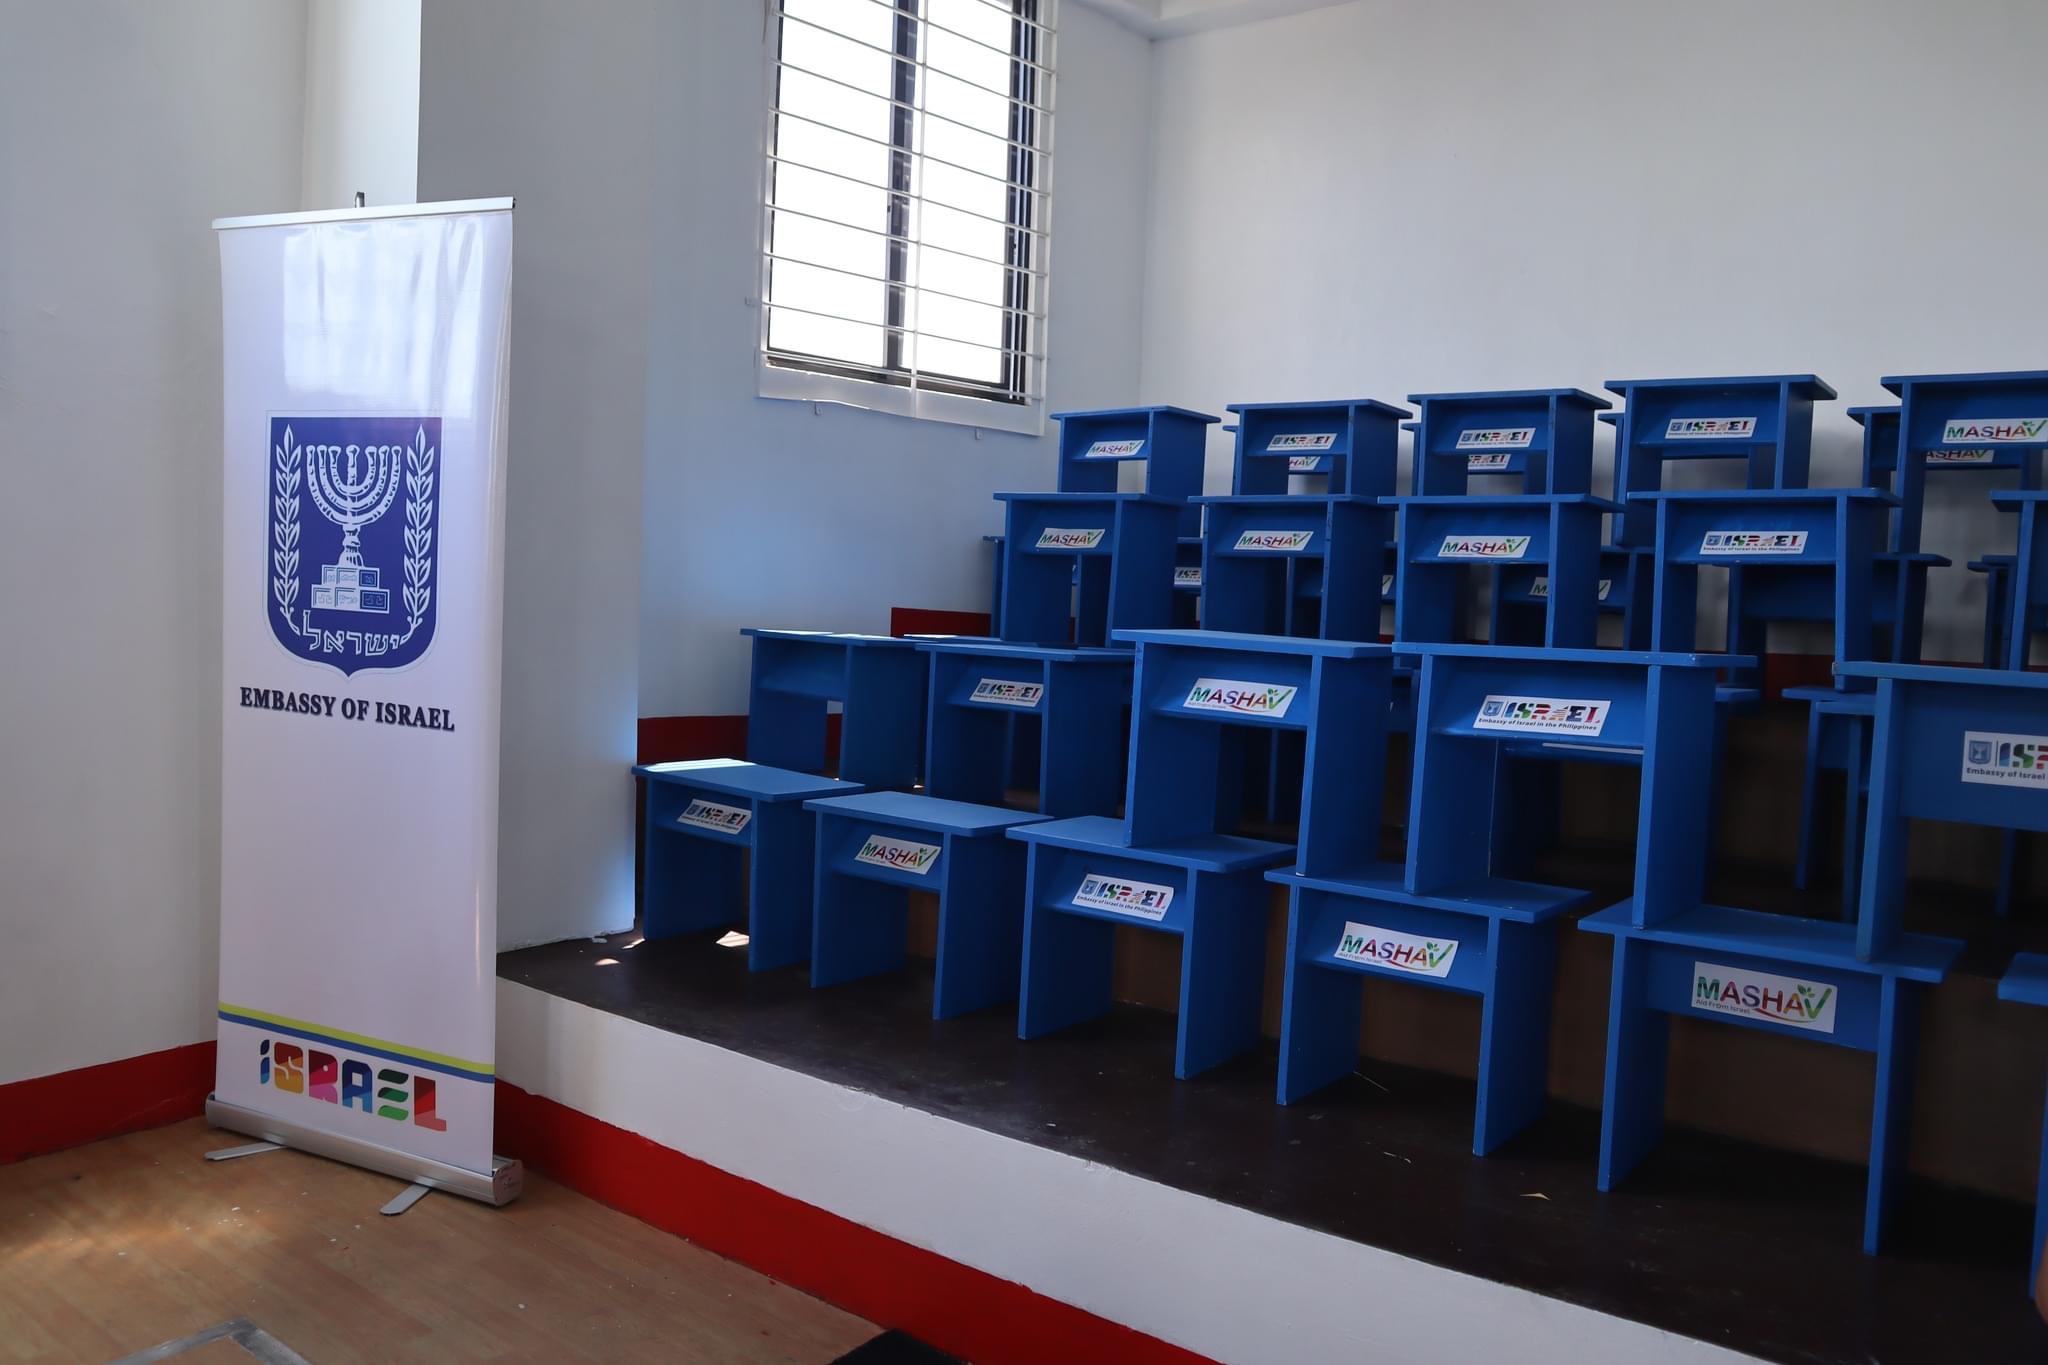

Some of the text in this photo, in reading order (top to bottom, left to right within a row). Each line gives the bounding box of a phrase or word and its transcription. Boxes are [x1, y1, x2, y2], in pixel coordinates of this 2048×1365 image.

[1946, 420, 2047, 439] MASHAV
[1040, 531, 1103, 544] MASHAV
[1240, 532, 1311, 546] MASHAV
[1442, 538, 1528, 553] MASHAV
[1723, 535, 1802, 546] ISRAEL
[1190, 687, 1293, 709] MASHAV
[240, 686, 456, 732] EMBASSY OF ISRAEL
[1504, 702, 1600, 723] ISRAEL
[1966, 768, 2006, 778] Embassy
[2019, 772, 2046, 780] Israel
[861, 843, 938, 867] MASHAV
[1097, 882, 1167, 909] ISRAEL
[1341, 935, 1454, 968] MASHAV
[1696, 976, 1833, 1019] MASHAV
